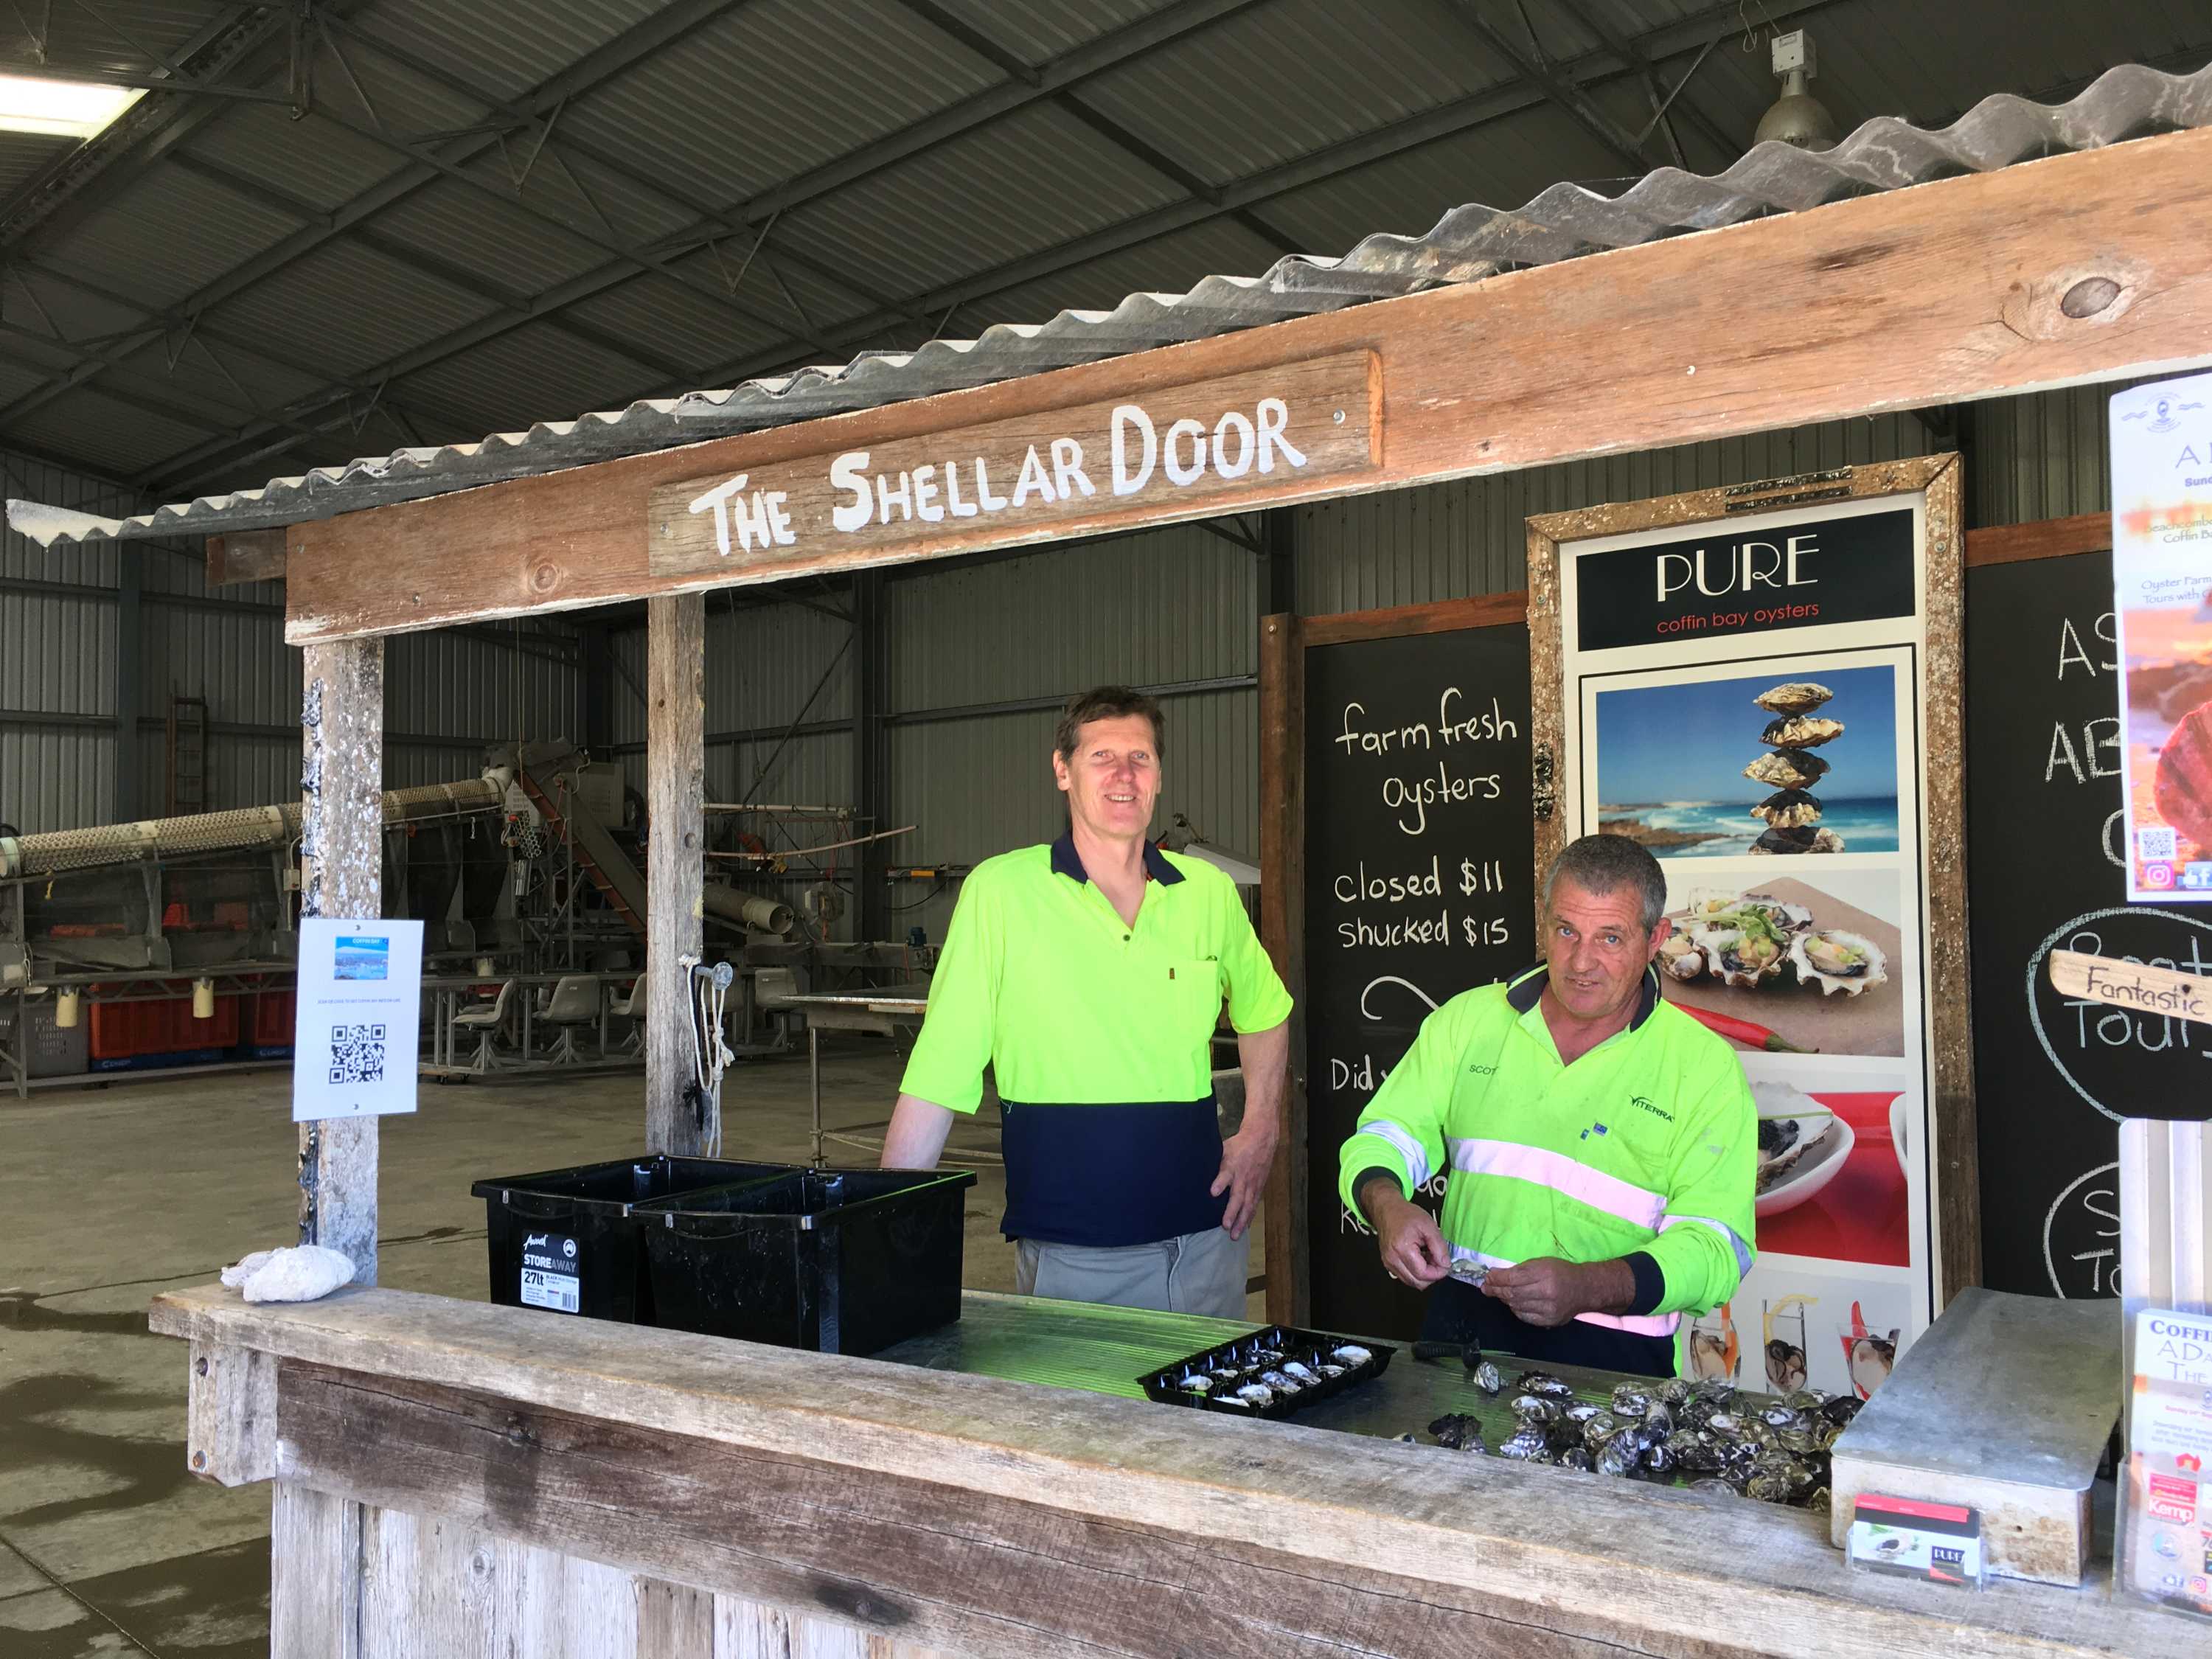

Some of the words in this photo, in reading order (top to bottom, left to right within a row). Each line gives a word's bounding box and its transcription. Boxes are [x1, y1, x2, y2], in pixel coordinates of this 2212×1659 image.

[689, 473, 797, 557] THE
[830, 437, 1096, 532] SHELLAR
[1110, 397, 1307, 496] DOOR
[2163, 529, 2199, 543] Coffin
[1657, 534, 1820, 602] PURE
[2140, 579, 2183, 593] Oyster
[2142, 595, 2175, 604] Tours
[2176, 587, 2200, 600] with
[1657, 615, 1707, 633] coffin
[1712, 611, 1750, 627] bay
[1753, 602, 1820, 624] oysters
[1335, 702, 1430, 756] farm
[1438, 686, 1518, 746] fresh
[1458, 857, 1504, 897] $11
[1462, 914, 1509, 947] $15
[2087, 964, 2207, 1017] Fantastic
[1330, 1054, 1374, 1091] Did
[524, 1234, 547, 1251] Award
[2149, 1319, 2212, 1344] COFFI
[2149, 1498, 2194, 1523] Kemp
